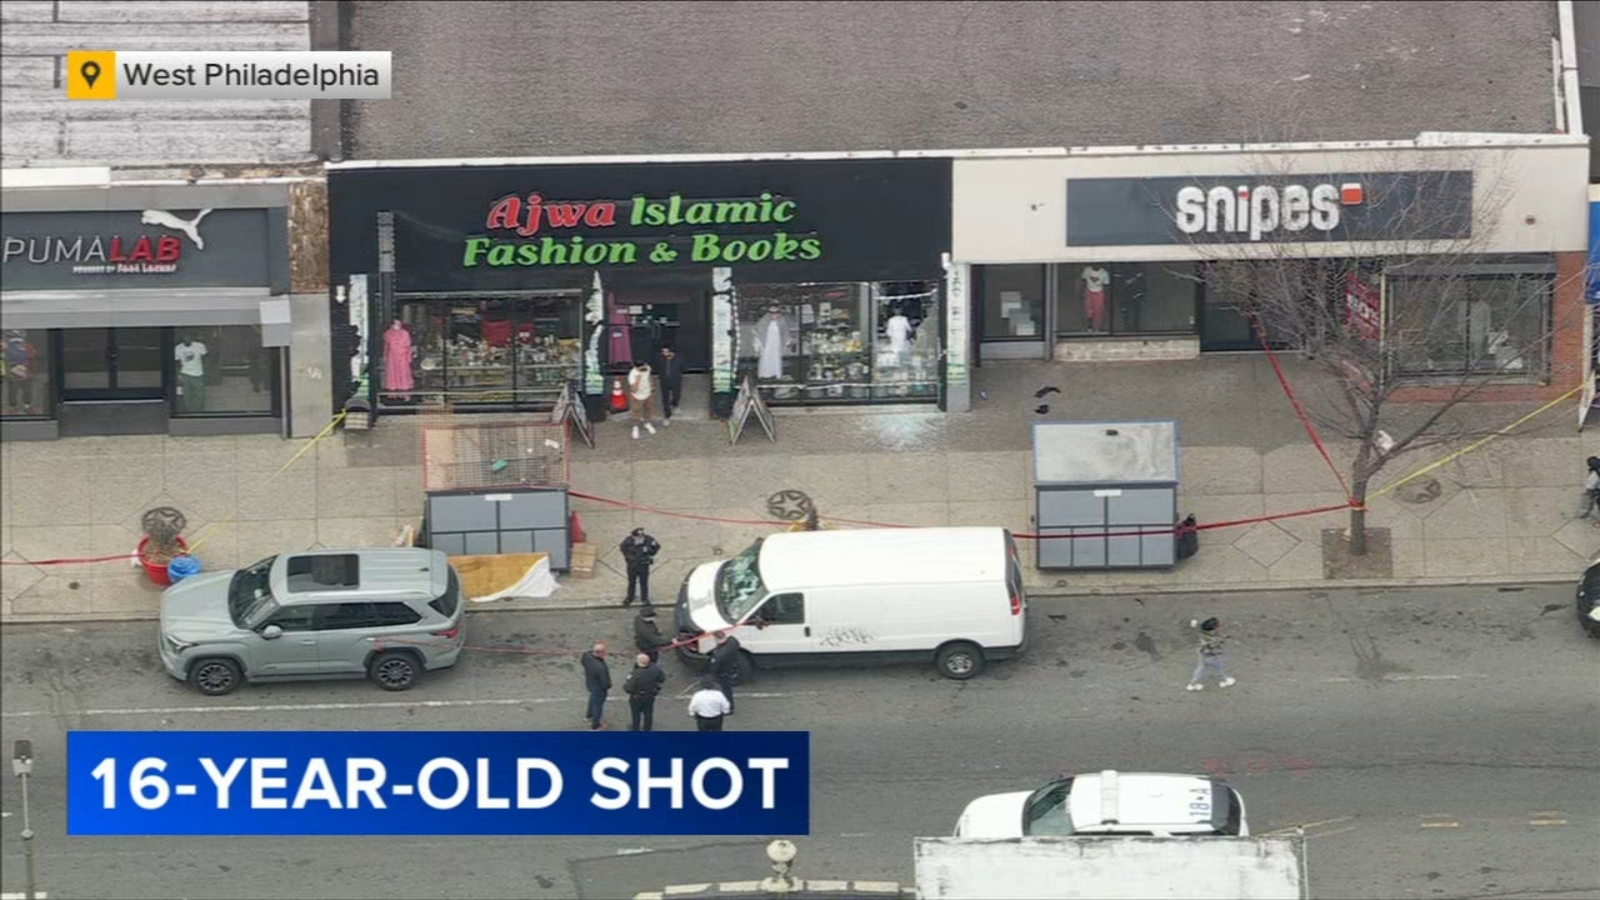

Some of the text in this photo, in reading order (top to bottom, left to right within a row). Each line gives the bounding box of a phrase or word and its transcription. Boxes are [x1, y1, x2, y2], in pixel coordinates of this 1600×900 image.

[486, 193, 797, 236] Ajwa Islamic
[1176, 184, 1339, 241] snipes
[463, 231, 822, 267] Fashion & Books
